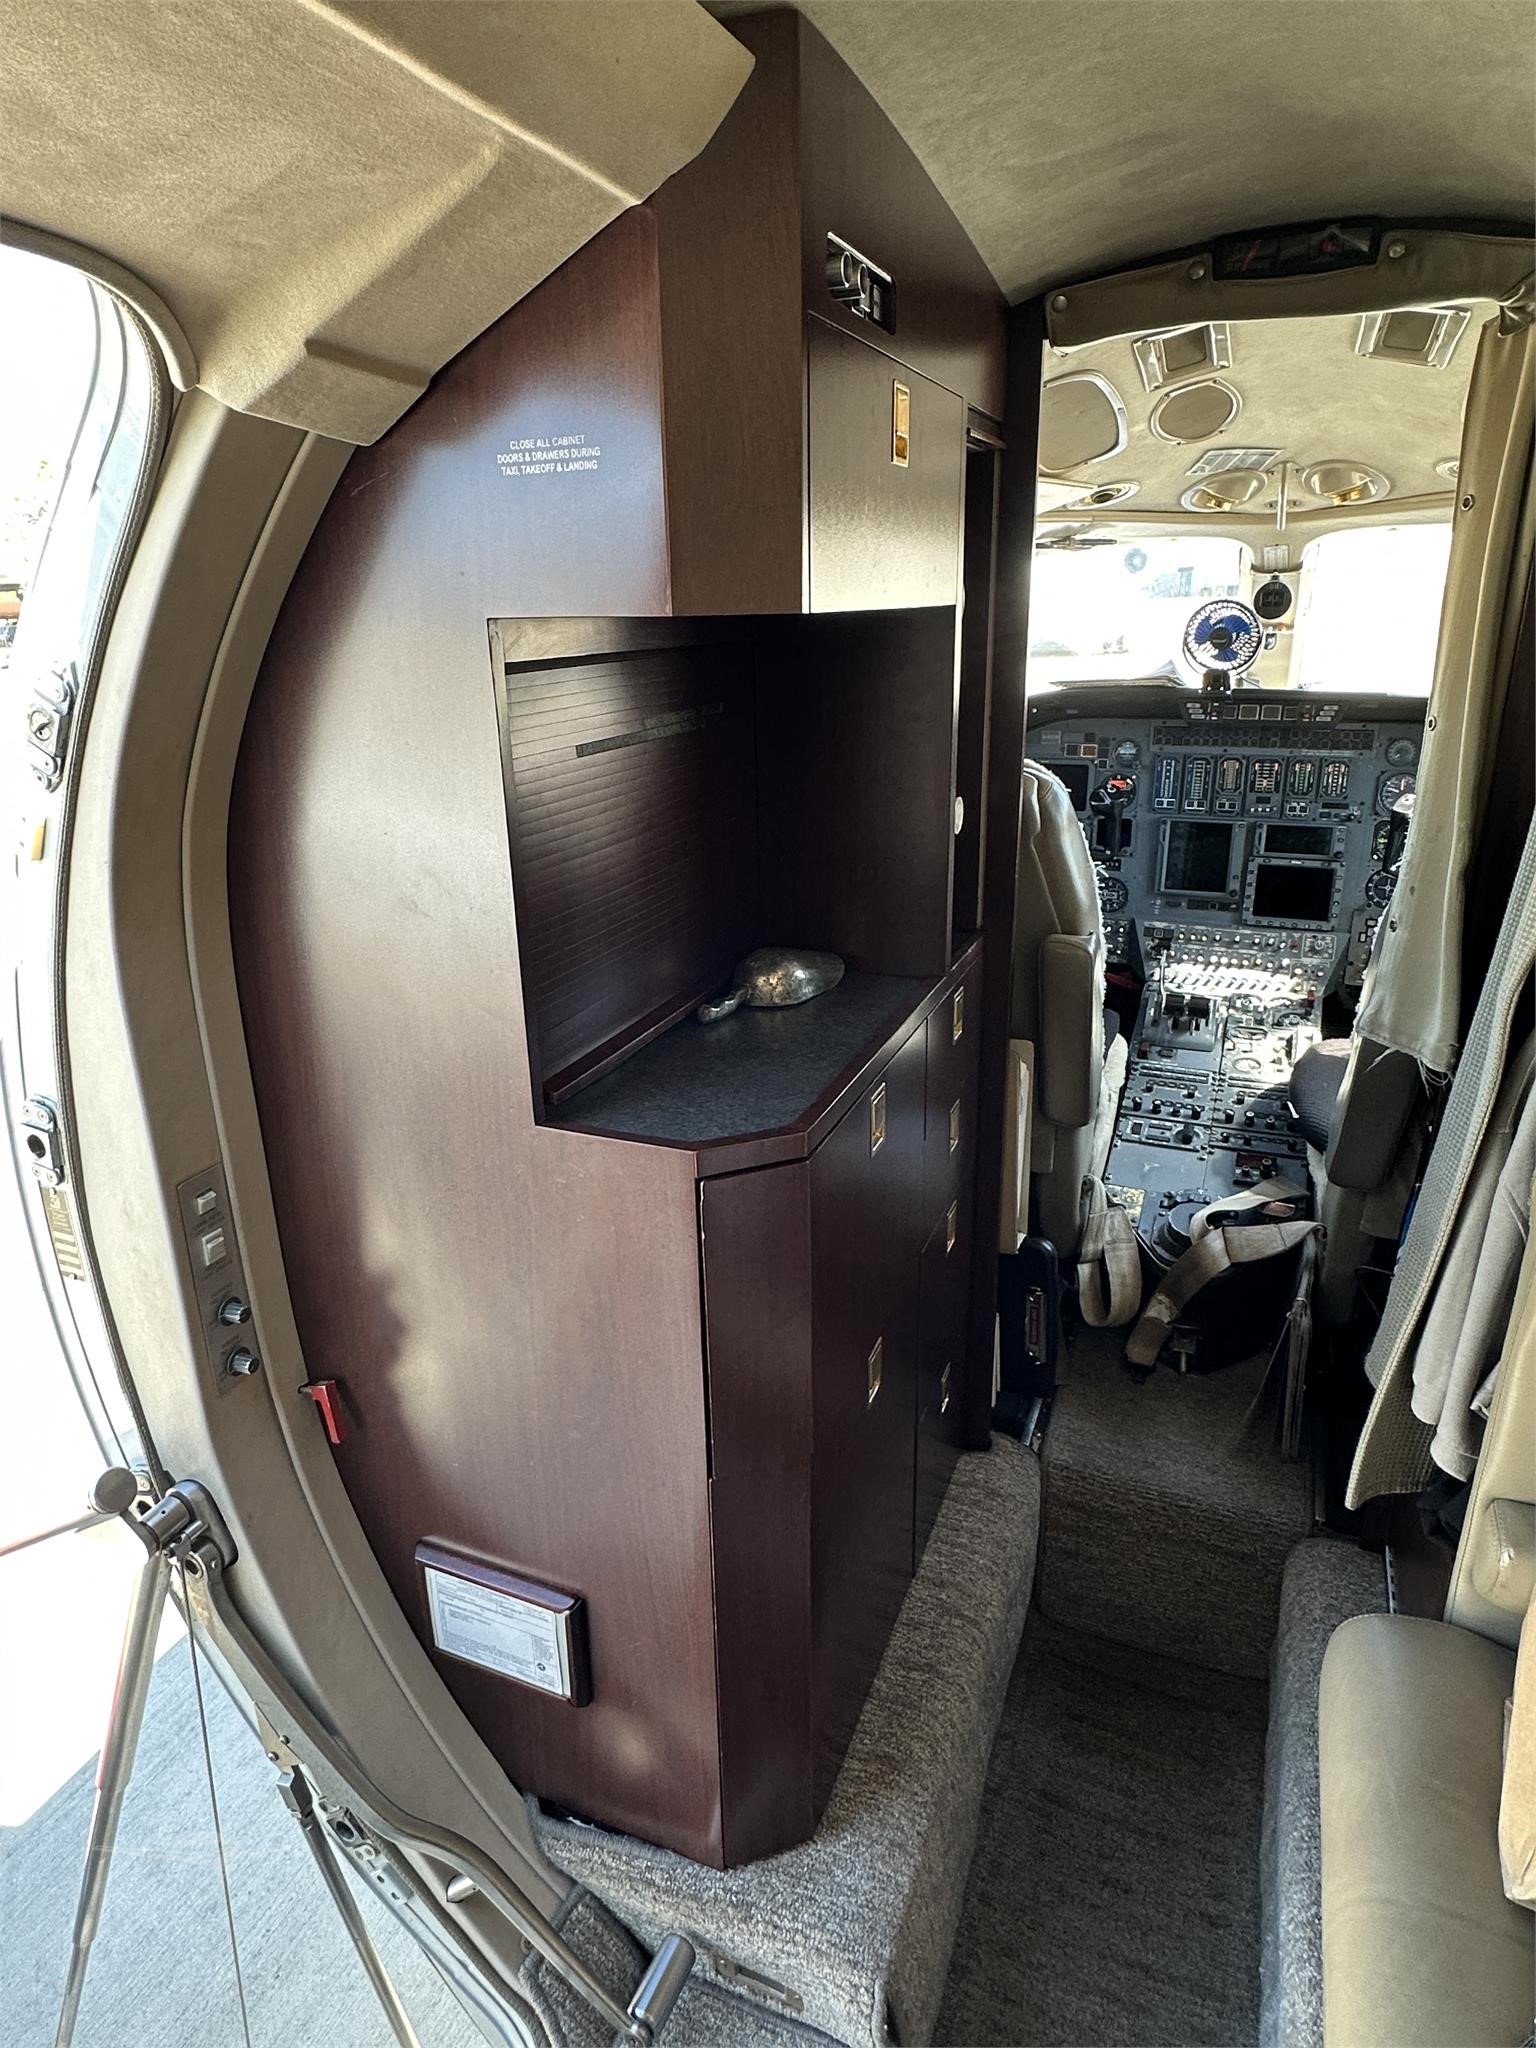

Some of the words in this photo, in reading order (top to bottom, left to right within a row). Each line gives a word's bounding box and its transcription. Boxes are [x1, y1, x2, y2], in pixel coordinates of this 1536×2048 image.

[510, 438, 535, 450] CLOSE
[536, 438, 551, 448] ALL
[552, 434, 585, 446] CABINET
[497, 452, 524, 463] DOORS
[525, 452, 531, 462] &
[532, 449, 569, 461] DRAWERS
[571, 446, 600, 458] DURING
[521, 463, 555, 475] TAKEOFF
[556, 462, 563, 472] &
[564, 460, 598, 472] LANDING
